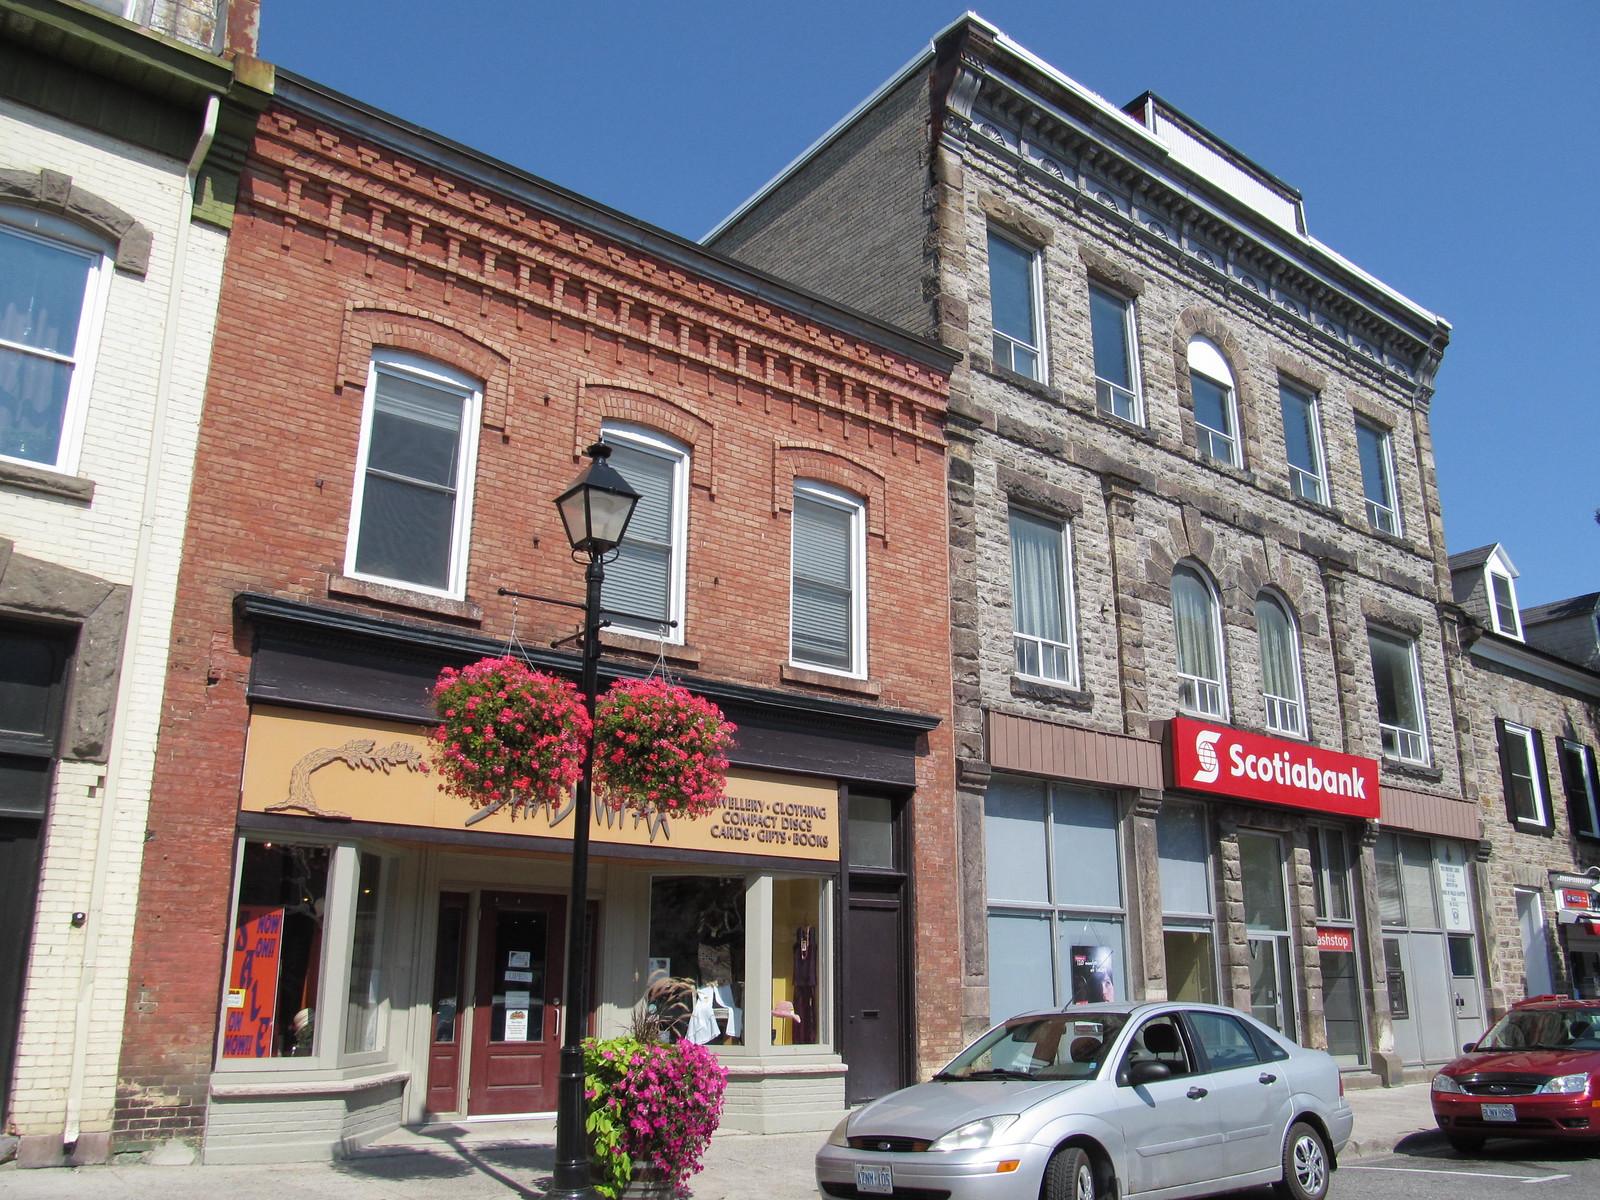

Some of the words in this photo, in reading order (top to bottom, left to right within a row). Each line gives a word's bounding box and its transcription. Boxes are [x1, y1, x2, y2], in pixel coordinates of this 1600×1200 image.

[1229, 743, 1367, 800] Scotiabank
[772, 802, 827, 820] CLOTHING
[721, 811, 778, 829] COMPACT
[781, 817, 812, 833] DISCS
[710, 825, 750, 842] CARDS
[756, 830, 787, 845] GIFTS
[792, 832, 829, 849] BOOKS
[256, 914, 282, 934] NOW
[1317, 932, 1349, 950] ashstop
[228, 1011, 244, 1032] ON
